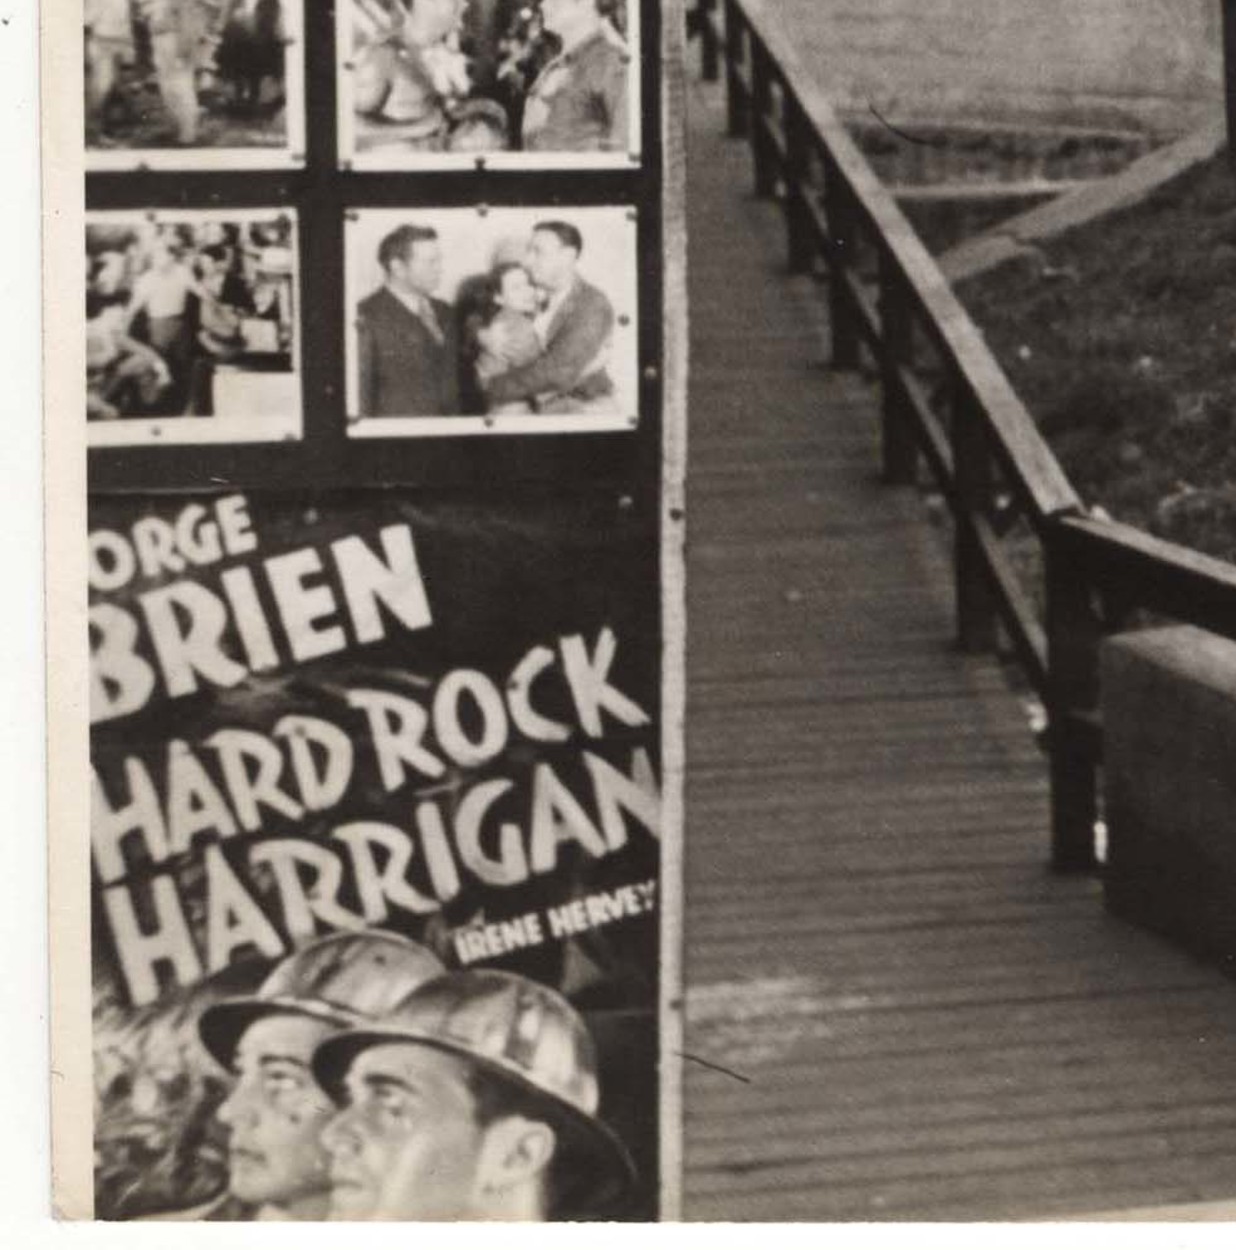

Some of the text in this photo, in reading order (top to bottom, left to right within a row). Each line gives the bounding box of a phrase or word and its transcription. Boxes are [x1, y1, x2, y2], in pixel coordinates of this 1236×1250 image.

[91, 626, 651, 884] HARD ROCK
[104, 747, 660, 1007] HARRIGAN
[454, 879, 656, 964] IRENE HERVEY
